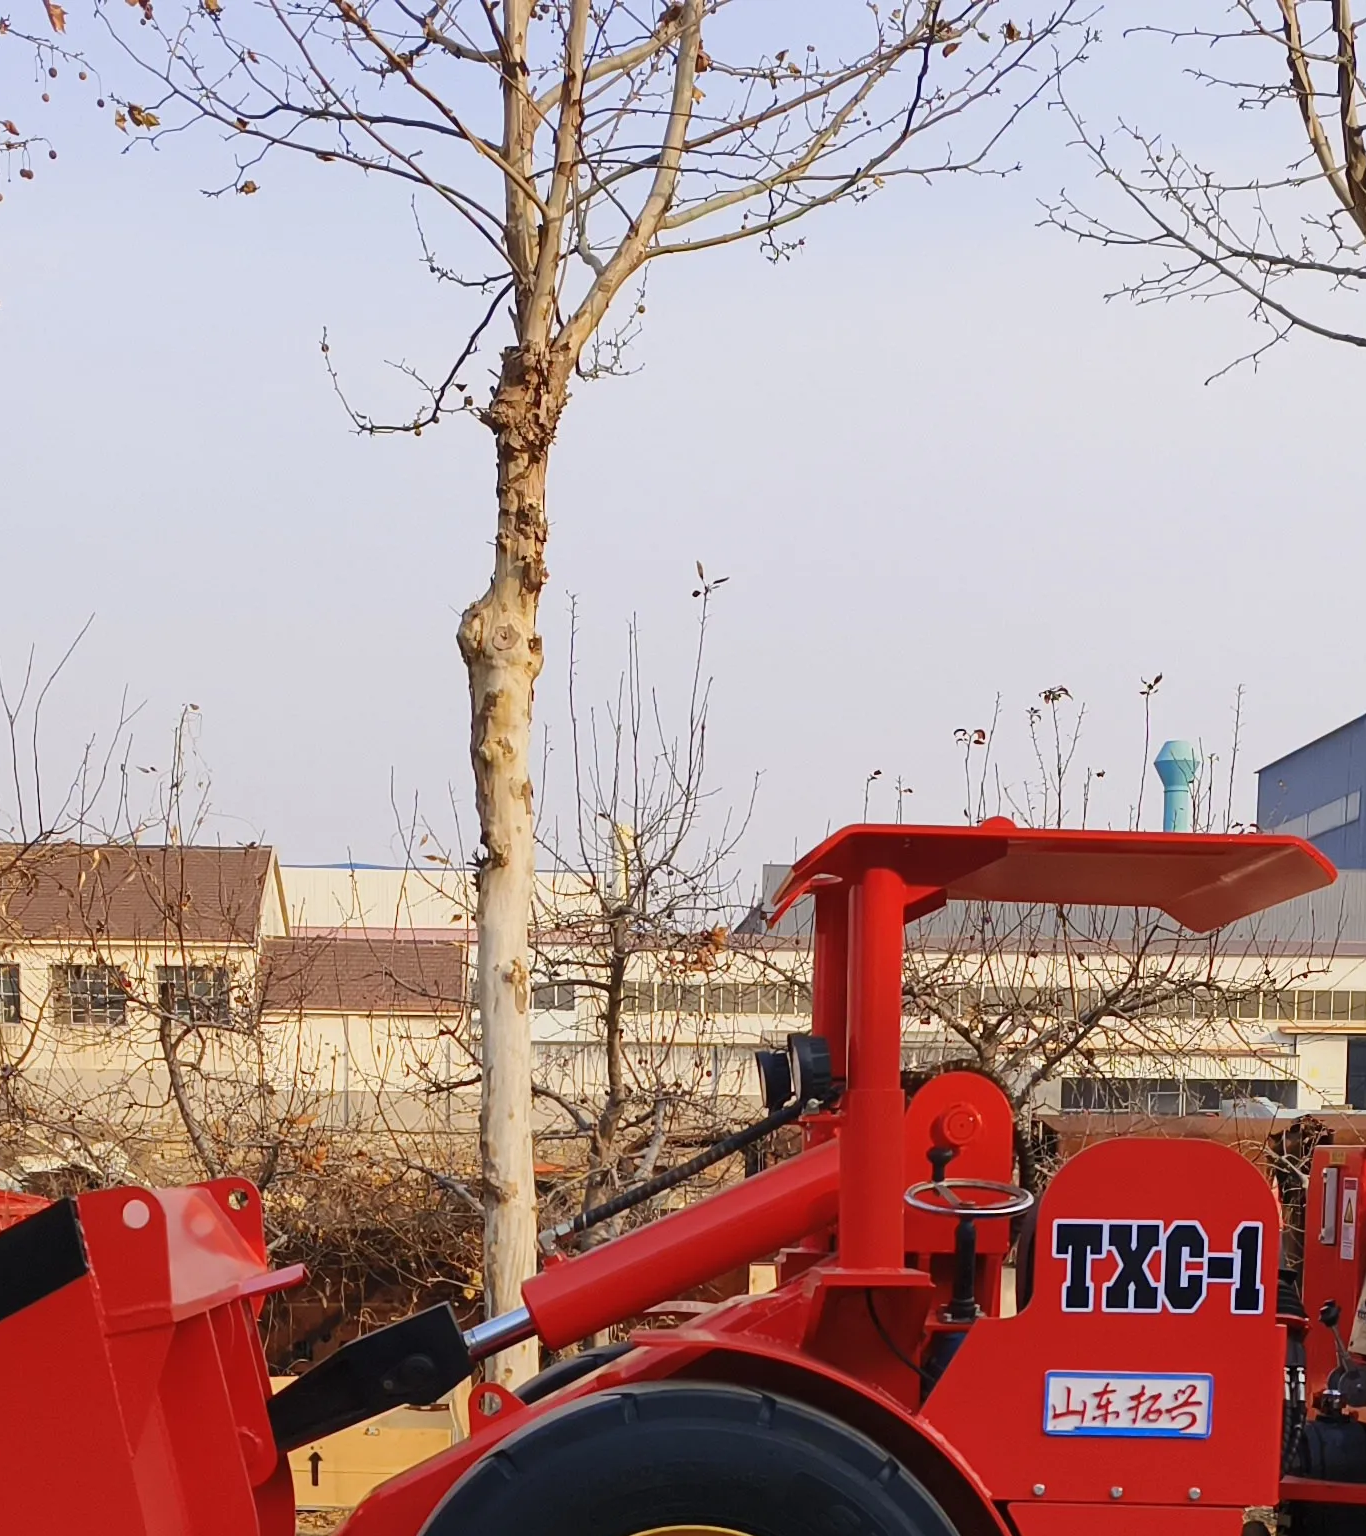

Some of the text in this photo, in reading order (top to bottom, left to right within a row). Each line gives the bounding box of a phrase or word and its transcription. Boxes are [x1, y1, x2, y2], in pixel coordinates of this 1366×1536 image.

[1052, 1219, 1265, 1314] TXC-1
[1051, 1381, 1203, 1431] 山东拓兴
